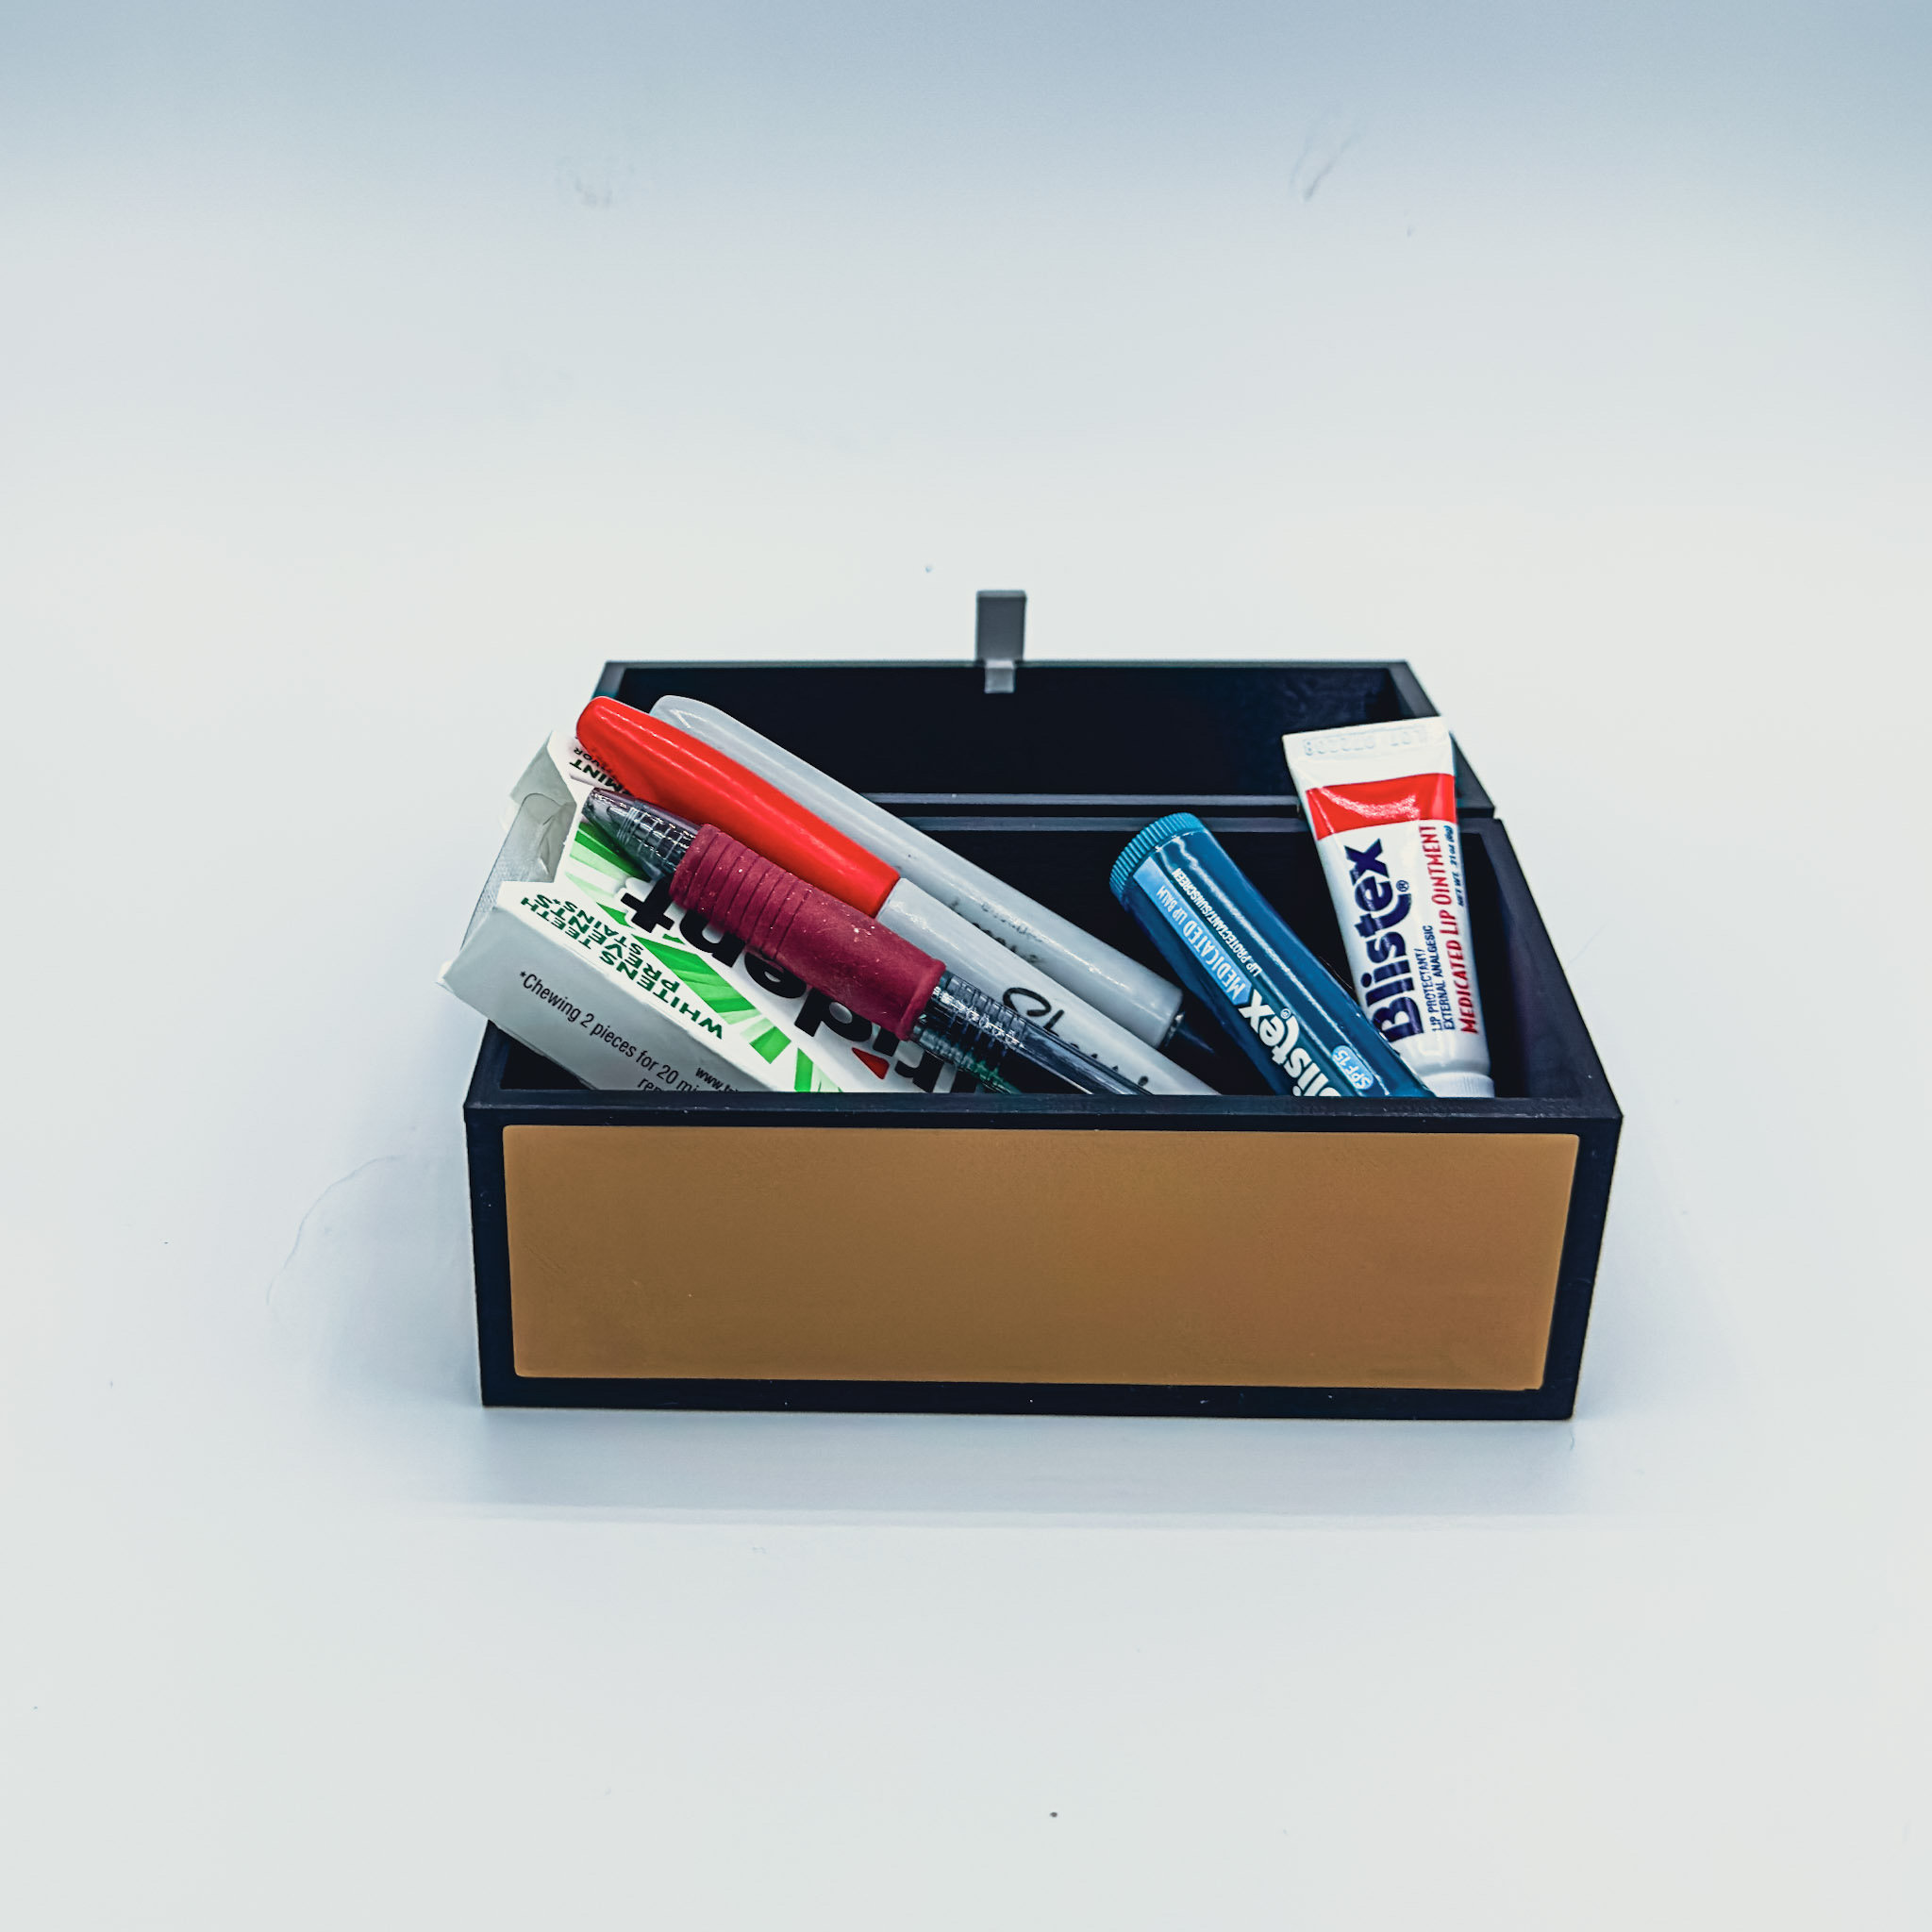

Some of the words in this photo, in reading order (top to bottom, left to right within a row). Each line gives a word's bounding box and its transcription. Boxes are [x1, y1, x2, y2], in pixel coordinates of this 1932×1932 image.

[1418, 826, 1453, 906] OINTMENT
[520, 896, 592, 950] TEETH
[1156, 884, 1179, 913] BALM
[1171, 868, 1255, 965] PROTECTANT/SUNSCREEN
[1173, 908, 1189, 924] LIP
[1439, 909, 1459, 936] LIP
[536, 893, 680, 993] PREVENTS
[1182, 919, 1246, 1001] MEDICATED
[1344, 838, 1424, 1043] Blistex
[1422, 924, 1444, 979] ANALGESIC
[599, 950, 723, 1040] WHITENS
[1246, 960, 1263, 977] LIP
[1414, 947, 1440, 1009] PROTECTANT/
[1445, 939, 1479, 1035] MEDICATED
[1432, 1010, 1442, 1032] LIP
[1434, 980, 1456, 1030] EXTERNAL
[580, 1012, 595, 1028] 2
[589, 1024, 637, 1058] pieces
[636, 1050, 659, 1072] for
[656, 1064, 679, 1085] 20
[1335, 1048, 1351, 1066] 15
[1344, 1065, 1372, 1090] SPF
